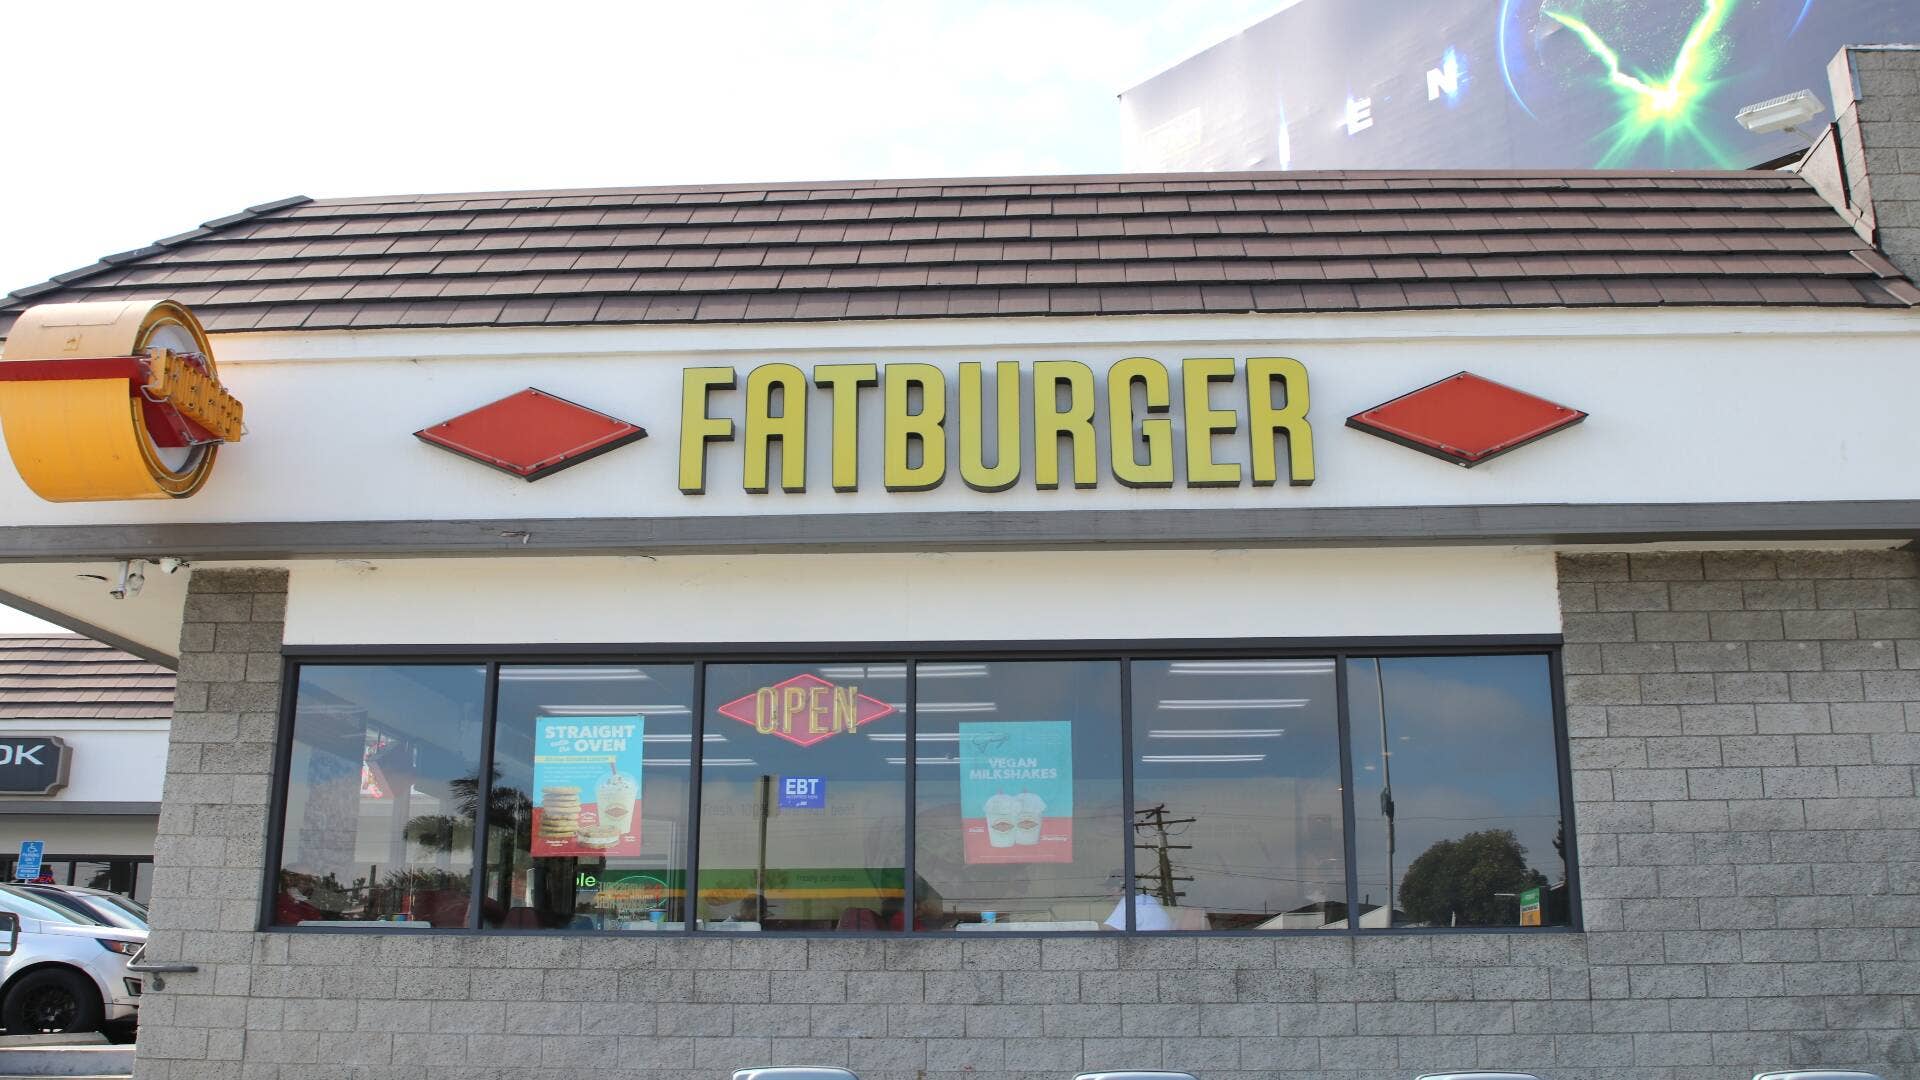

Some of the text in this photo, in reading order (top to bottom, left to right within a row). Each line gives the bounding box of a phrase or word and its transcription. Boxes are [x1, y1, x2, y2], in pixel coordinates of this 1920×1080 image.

[679, 356, 1315, 495] FATBURGER
[755, 686, 858, 734] OPEN
[545, 725, 636, 739] STRAIGHT
[574, 738, 626, 752] OVEN
[988, 757, 1038, 768] VEGAN
[970, 768, 1057, 779] MILKSHAKES
[786, 778, 819, 795] EBT
